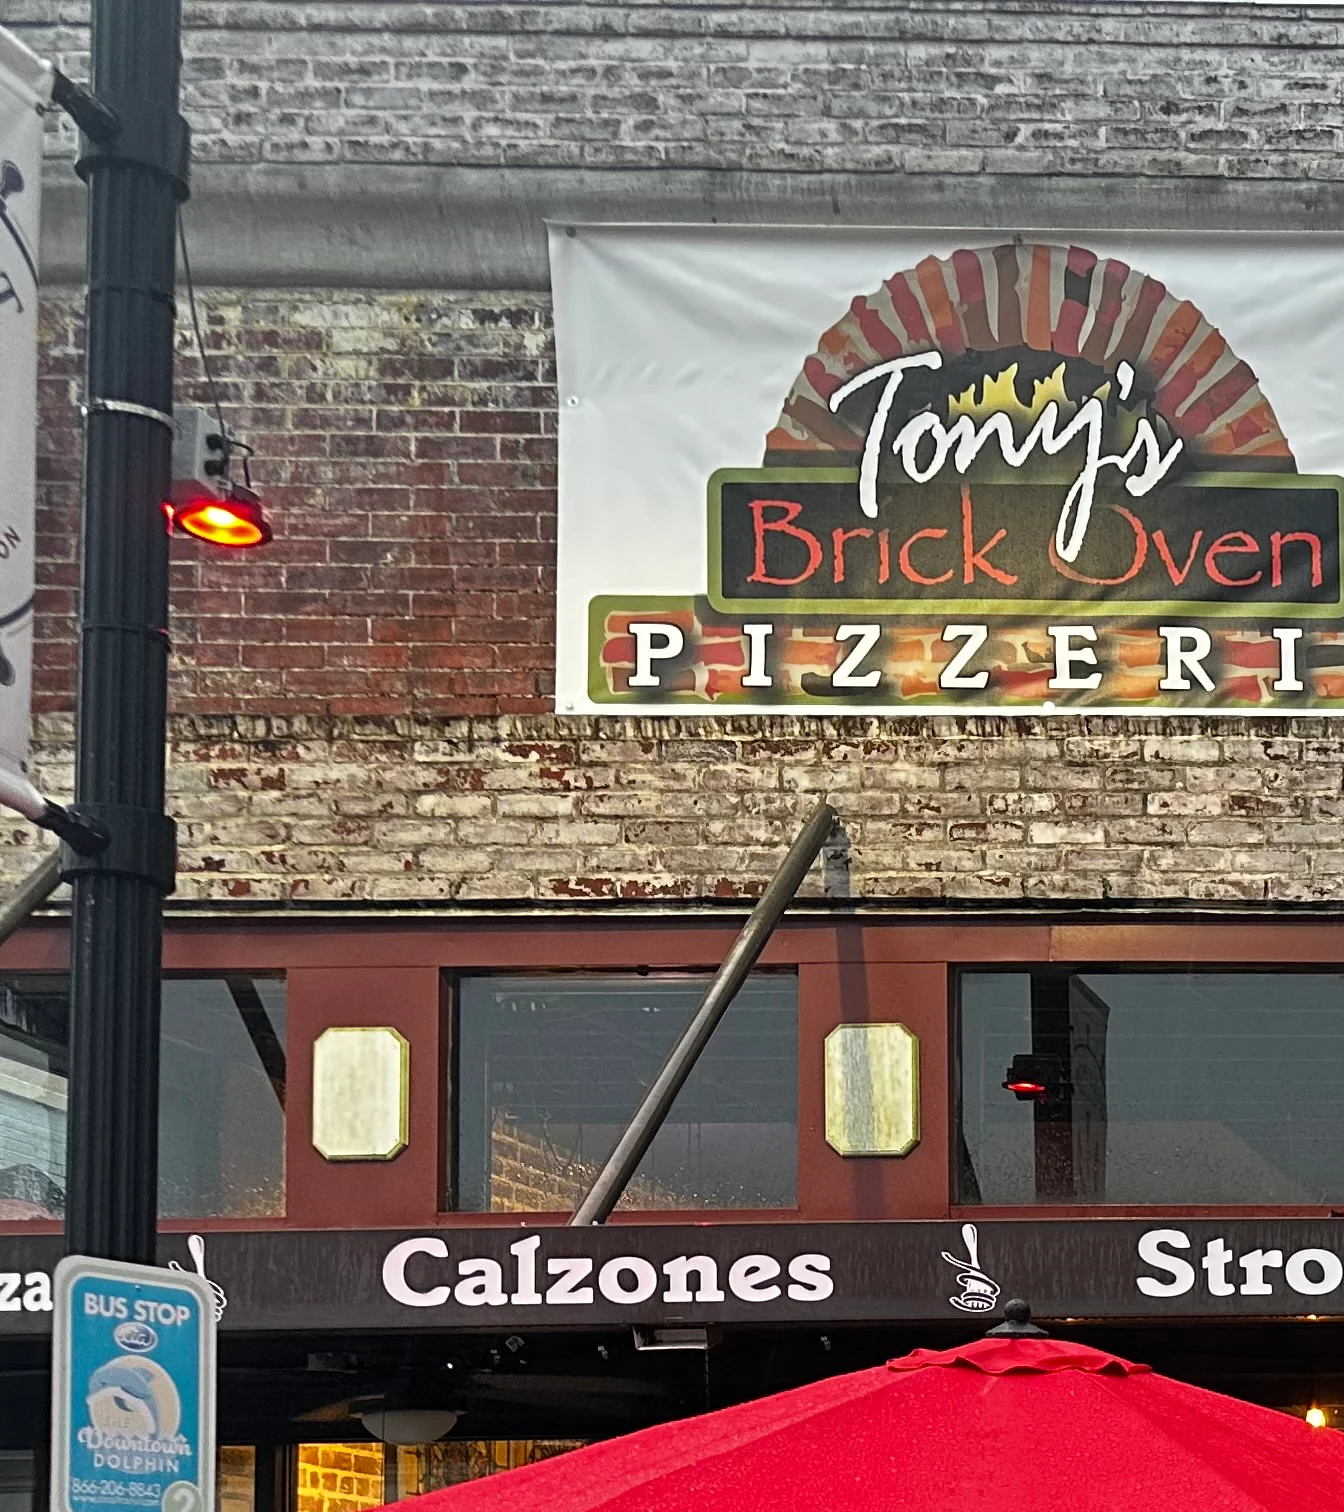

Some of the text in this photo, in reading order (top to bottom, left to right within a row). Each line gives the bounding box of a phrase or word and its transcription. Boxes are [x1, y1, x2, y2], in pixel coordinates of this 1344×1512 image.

[829, 350, 1183, 562] Tony's
[746, 482, 1324, 588] Brick Oven
[0, 1271, 54, 1312] za
[381, 1235, 835, 1308] Calzones
[84, 1292, 191, 1327] BUS STOP
[77, 1425, 193, 1455] Downtown
[93, 1453, 180, 1473] DOLPHIN
